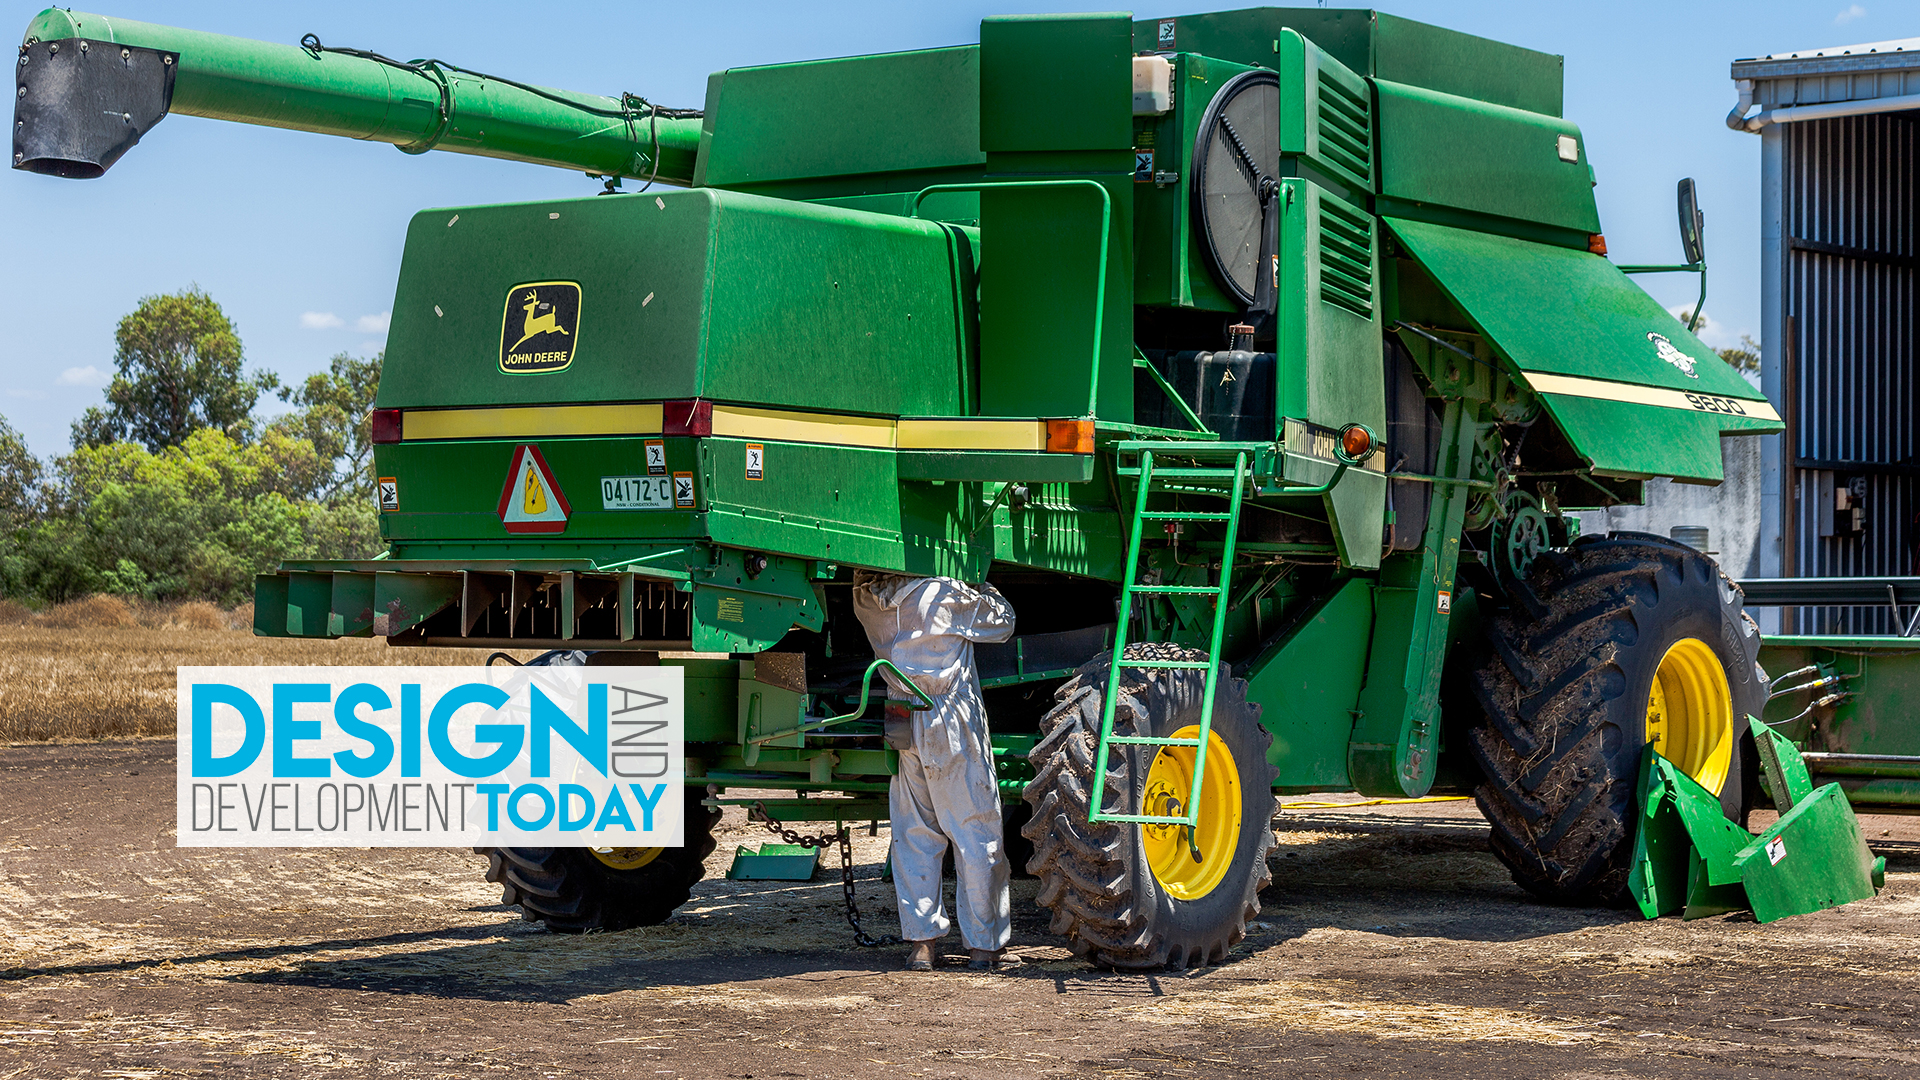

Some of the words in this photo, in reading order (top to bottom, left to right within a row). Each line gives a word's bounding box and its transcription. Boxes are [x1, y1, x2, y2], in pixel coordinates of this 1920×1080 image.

[505, 353, 532, 365] JOHN
[534, 351, 568, 363] DEERE
[1684, 393, 1747, 415] 9600
[1313, 430, 1335, 460] JOHN
